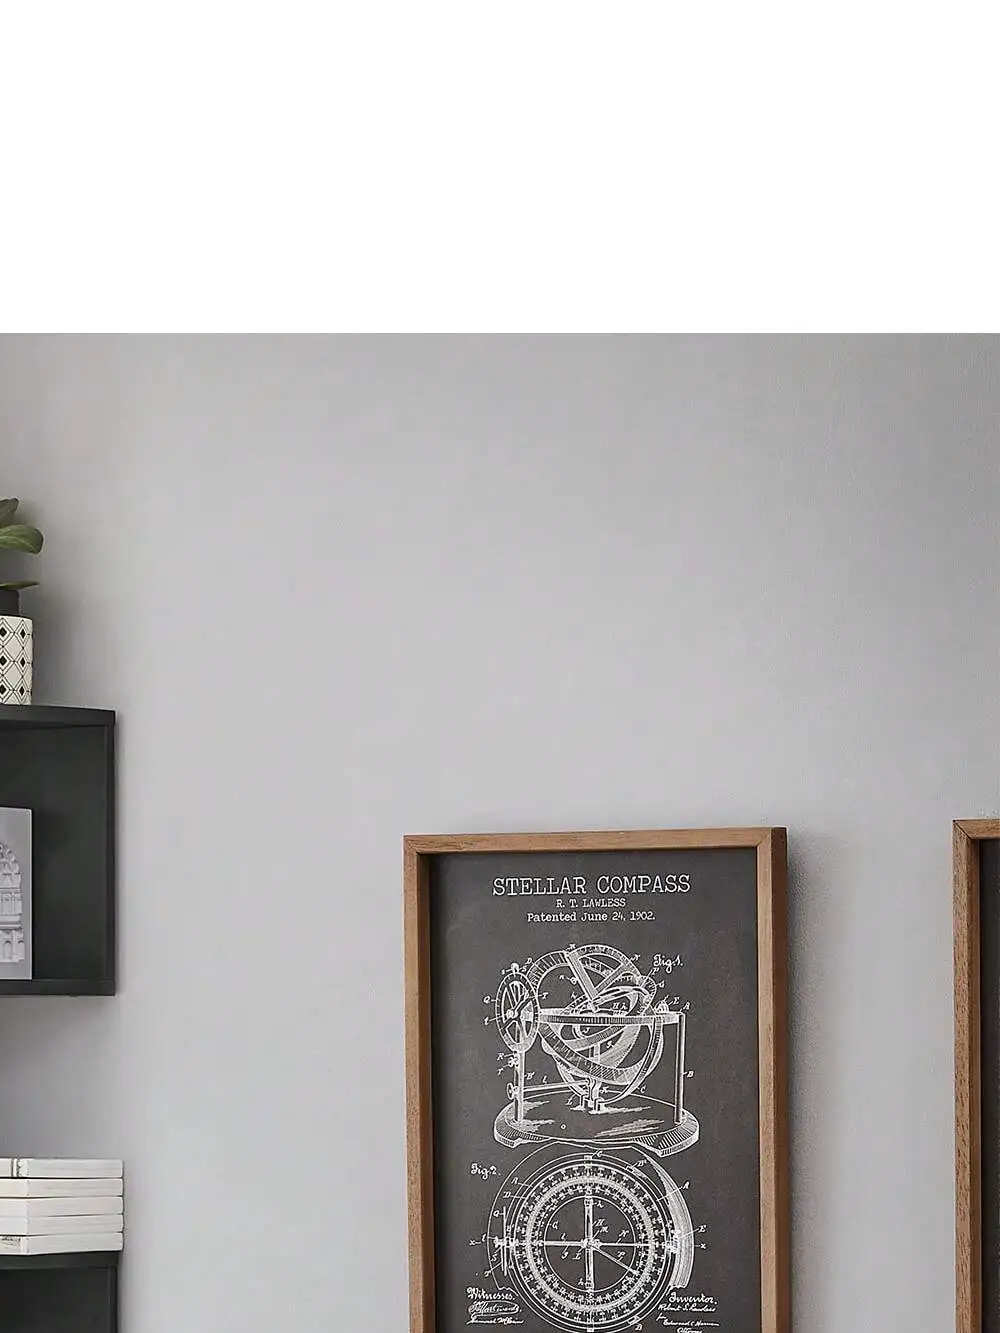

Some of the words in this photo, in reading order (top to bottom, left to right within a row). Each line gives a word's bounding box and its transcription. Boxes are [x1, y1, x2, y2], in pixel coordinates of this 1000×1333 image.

[492, 876, 587, 896] STELLAR
[597, 874, 691, 894] COMPASS
[556, 899, 565, 908] R.
[569, 899, 578, 908] T.
[582, 898, 626, 908] LAWLESS
[527, 912, 577, 922] Patented
[581, 912, 608, 922] June
[629, 911, 656, 921] 1902.
[466, 1287, 515, 1300] Witnesses.
[669, 1291, 718, 1305] Inventor.
